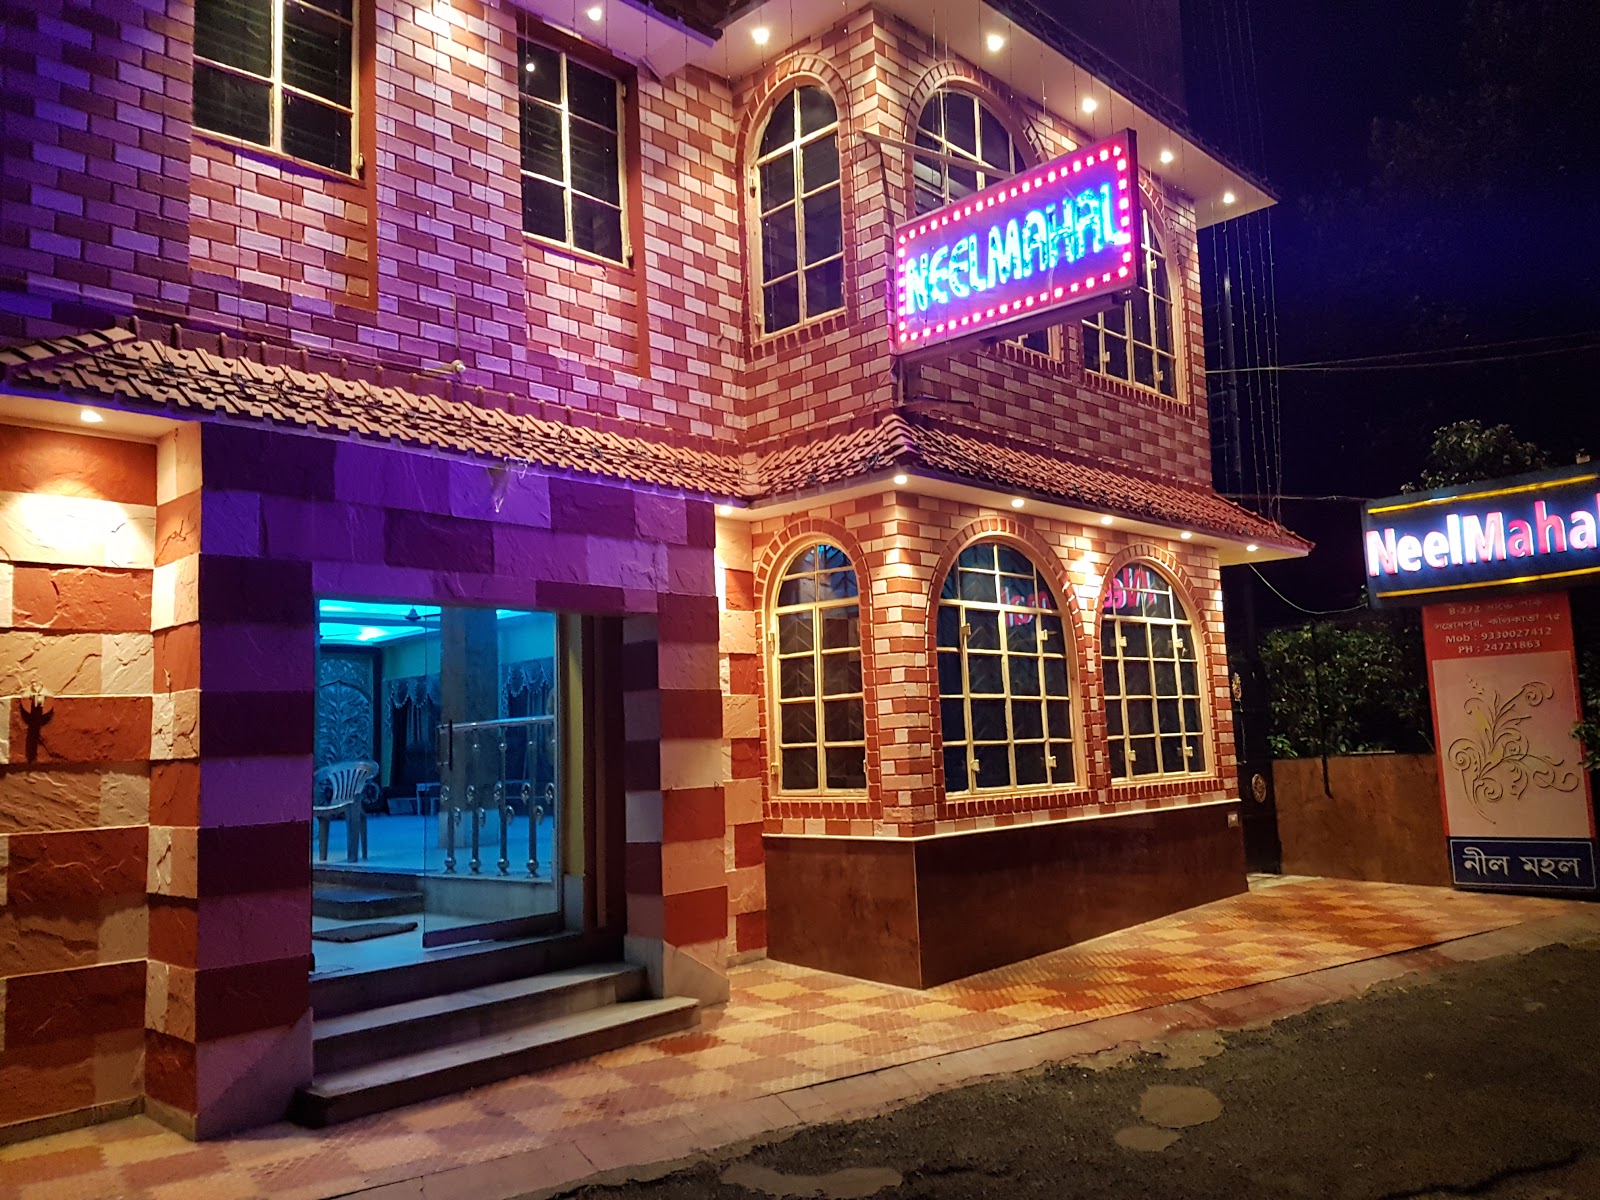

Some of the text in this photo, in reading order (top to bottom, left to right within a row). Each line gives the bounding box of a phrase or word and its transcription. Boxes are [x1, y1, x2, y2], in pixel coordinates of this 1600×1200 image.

[1445, 633, 1471, 644] Mob
[1457, 644, 1473, 654] PH
[1462, 847, 1581, 879] নীল মহল
